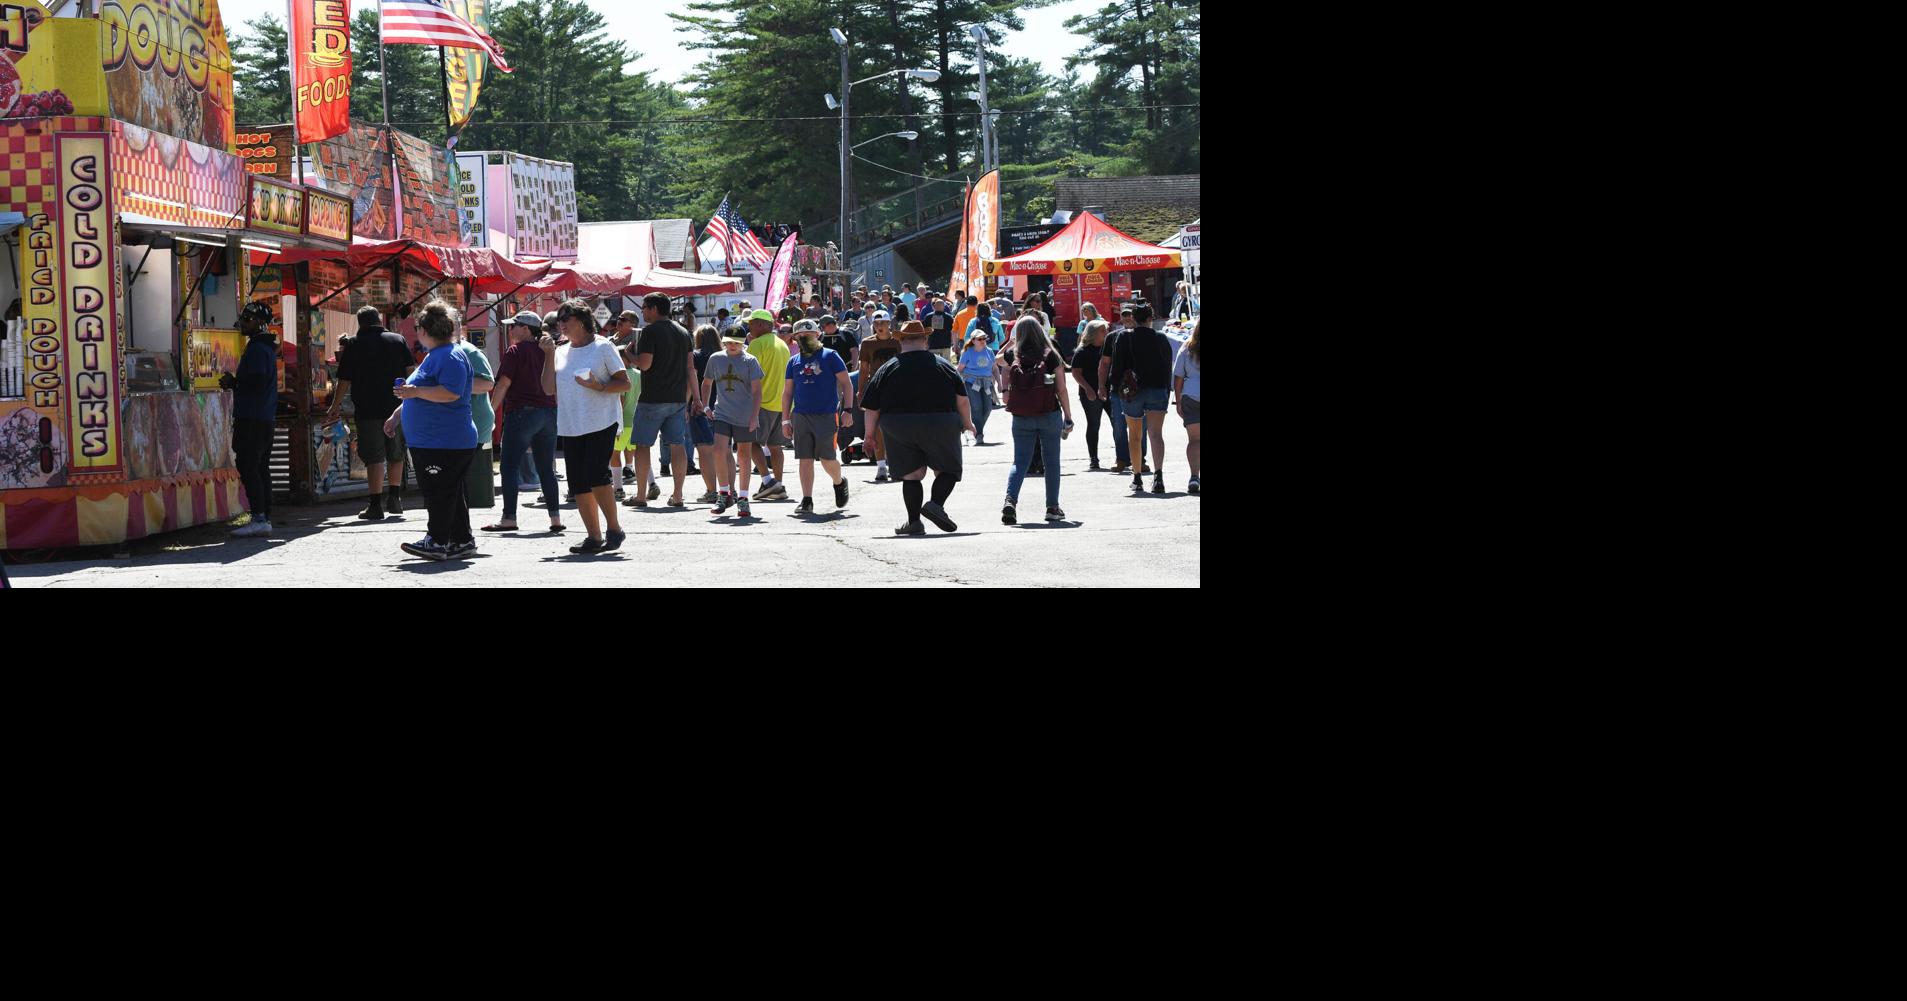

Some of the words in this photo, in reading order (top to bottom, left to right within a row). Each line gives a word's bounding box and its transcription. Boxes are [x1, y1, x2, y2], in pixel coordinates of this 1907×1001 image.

[101, 1, 233, 116] DOUGH
[236, 133, 271, 145] HOT
[29, 213, 56, 305] FRIED
[67, 156, 102, 269] COLD
[30, 318, 62, 407] DOUGH
[73, 286, 108, 457] DRINKS
